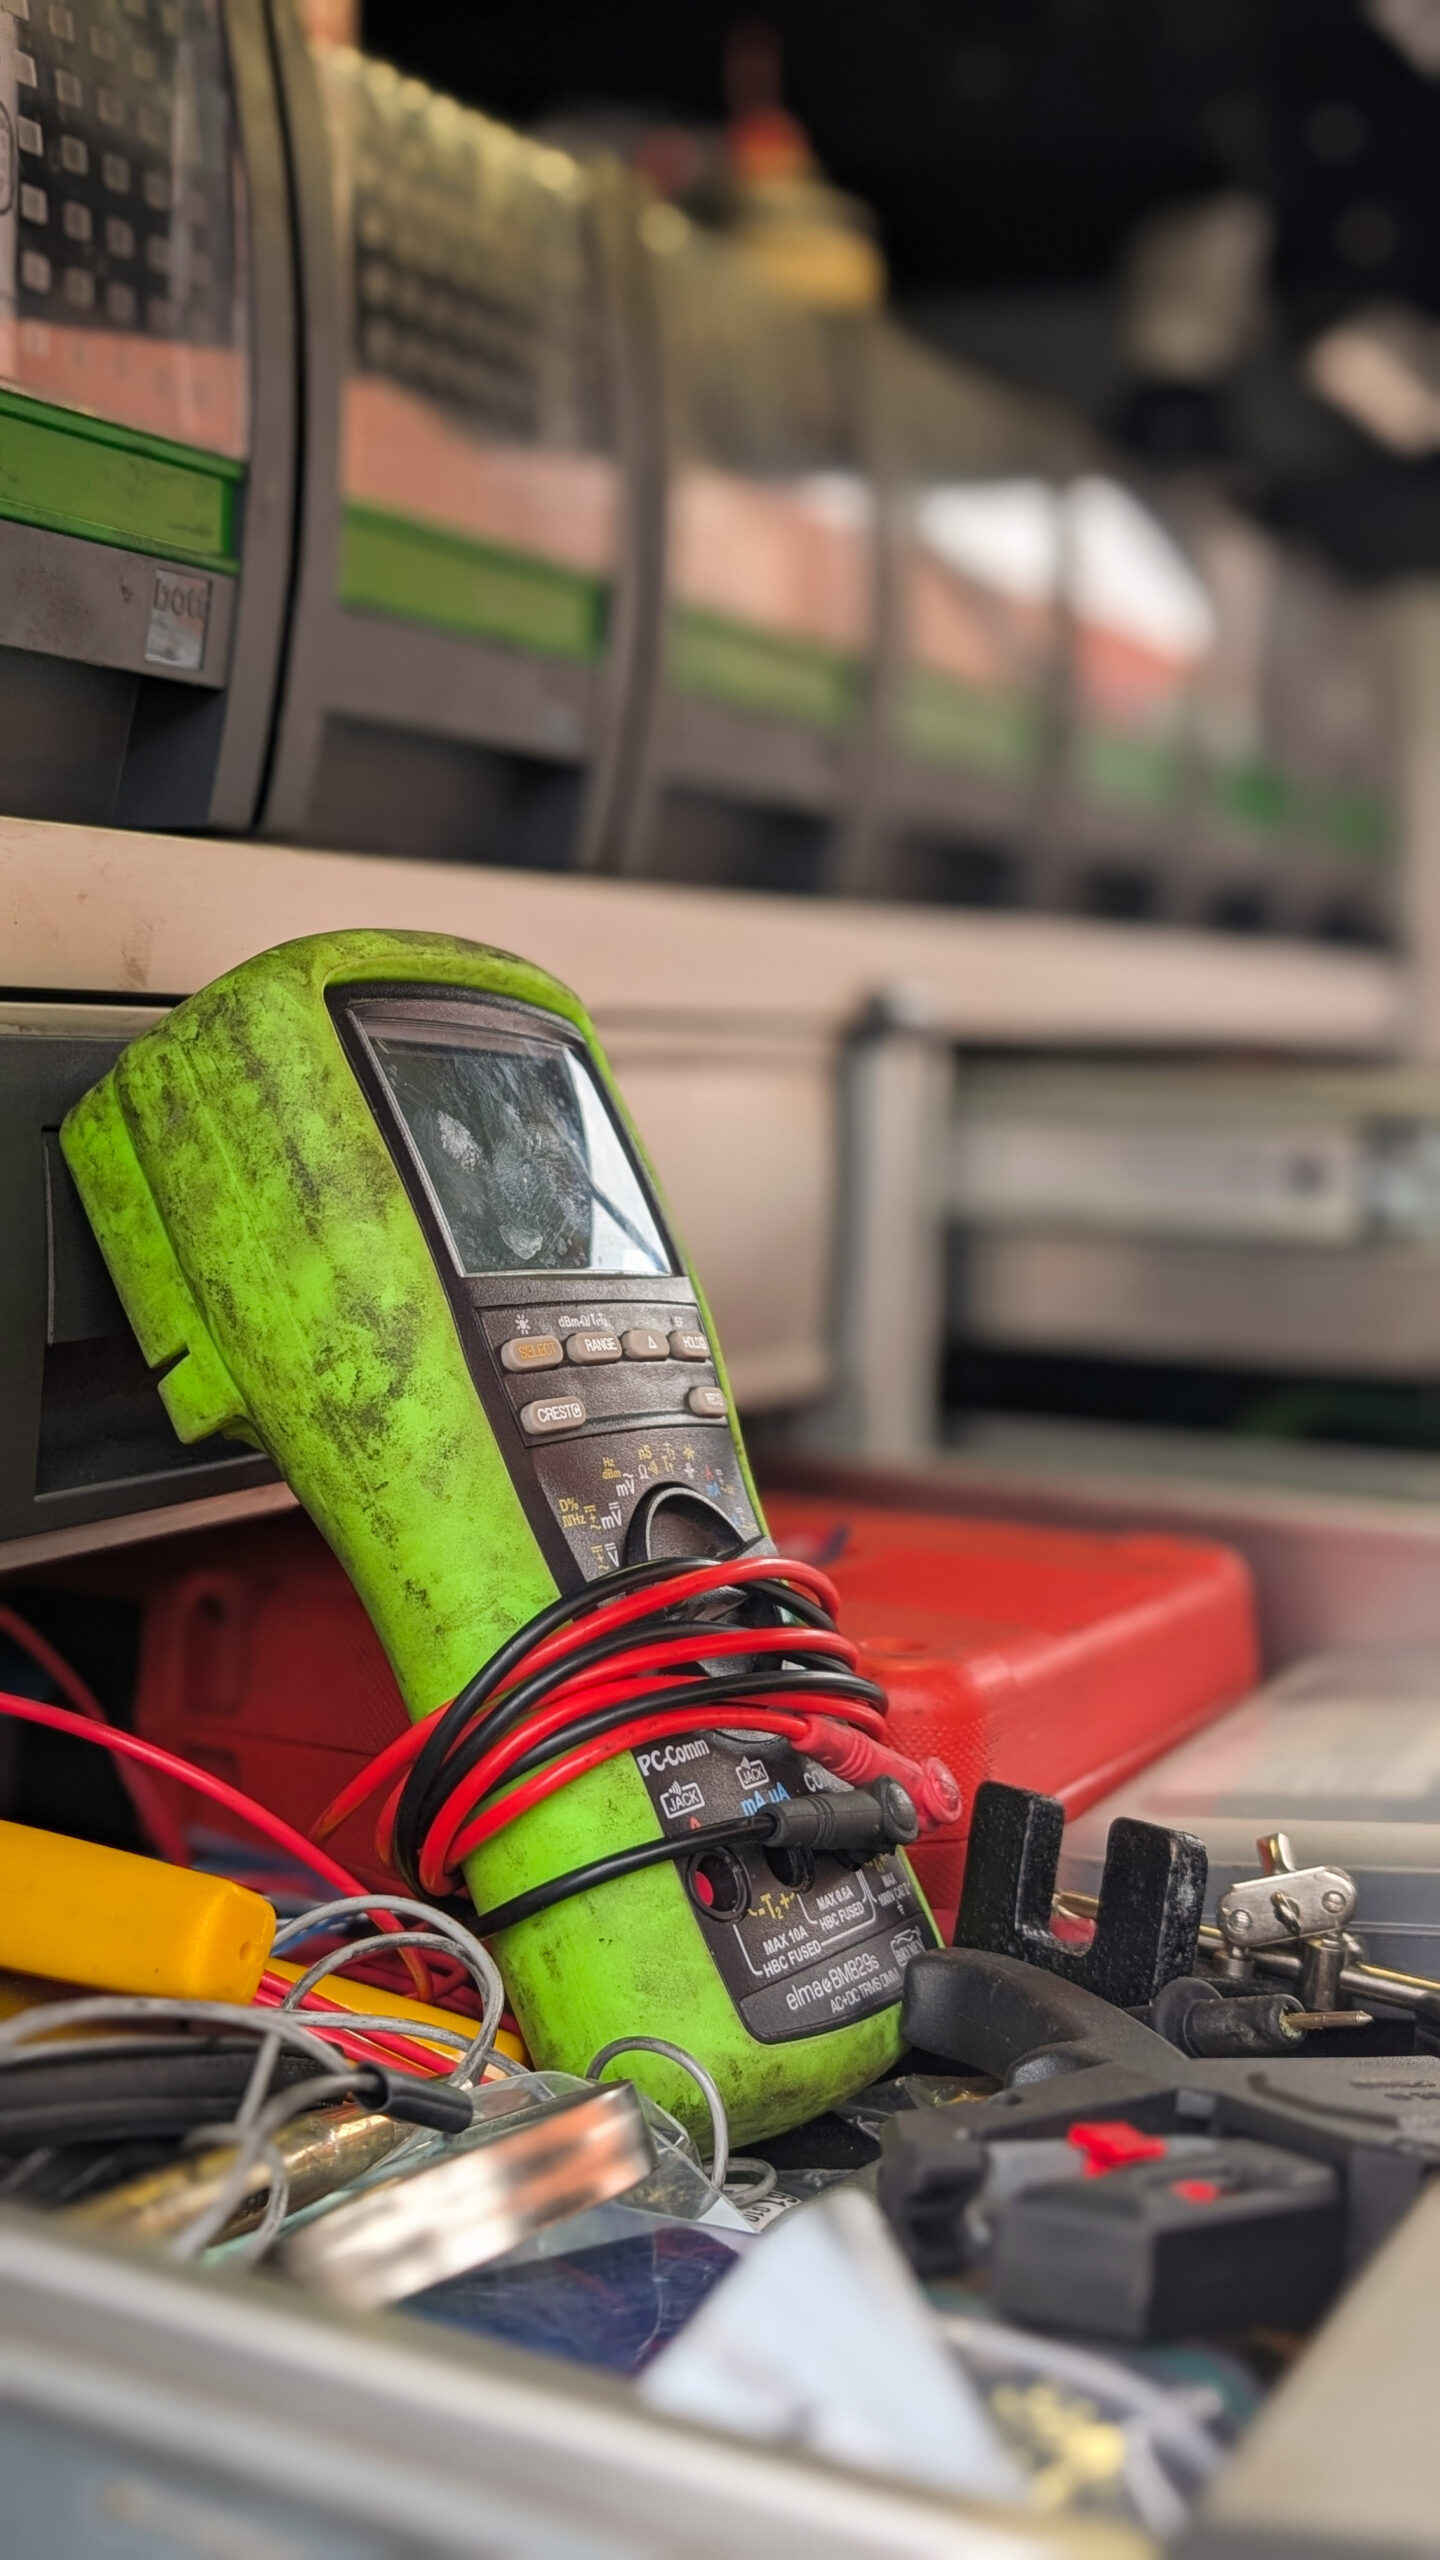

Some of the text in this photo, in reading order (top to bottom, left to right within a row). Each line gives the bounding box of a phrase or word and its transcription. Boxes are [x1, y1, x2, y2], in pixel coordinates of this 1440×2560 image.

[518, 1342, 555, 1359] SELECT
[584, 1337, 618, 1352] RANGE
[602, 1457, 615, 1467] Hz
[616, 1479, 635, 1497] mV
[559, 1497, 579, 1513] D%
[600, 1509, 622, 1530] mV
[637, 1739, 710, 1776] PC-Comm
[742, 1767, 766, 1785] JACK
[670, 1790, 699, 1812] JACK
[741, 1791, 766, 1816] mA
[816, 1889, 837, 1911] MAX
[819, 1901, 865, 1932] HBC FUSED
[763, 1925, 809, 1955] MAX 10A
[763, 1940, 822, 1978] HBC FUSED
[786, 1979, 824, 2011] elma
[830, 1988, 860, 2014] AC+DC
[857, 1977, 883, 2002] TRMS
